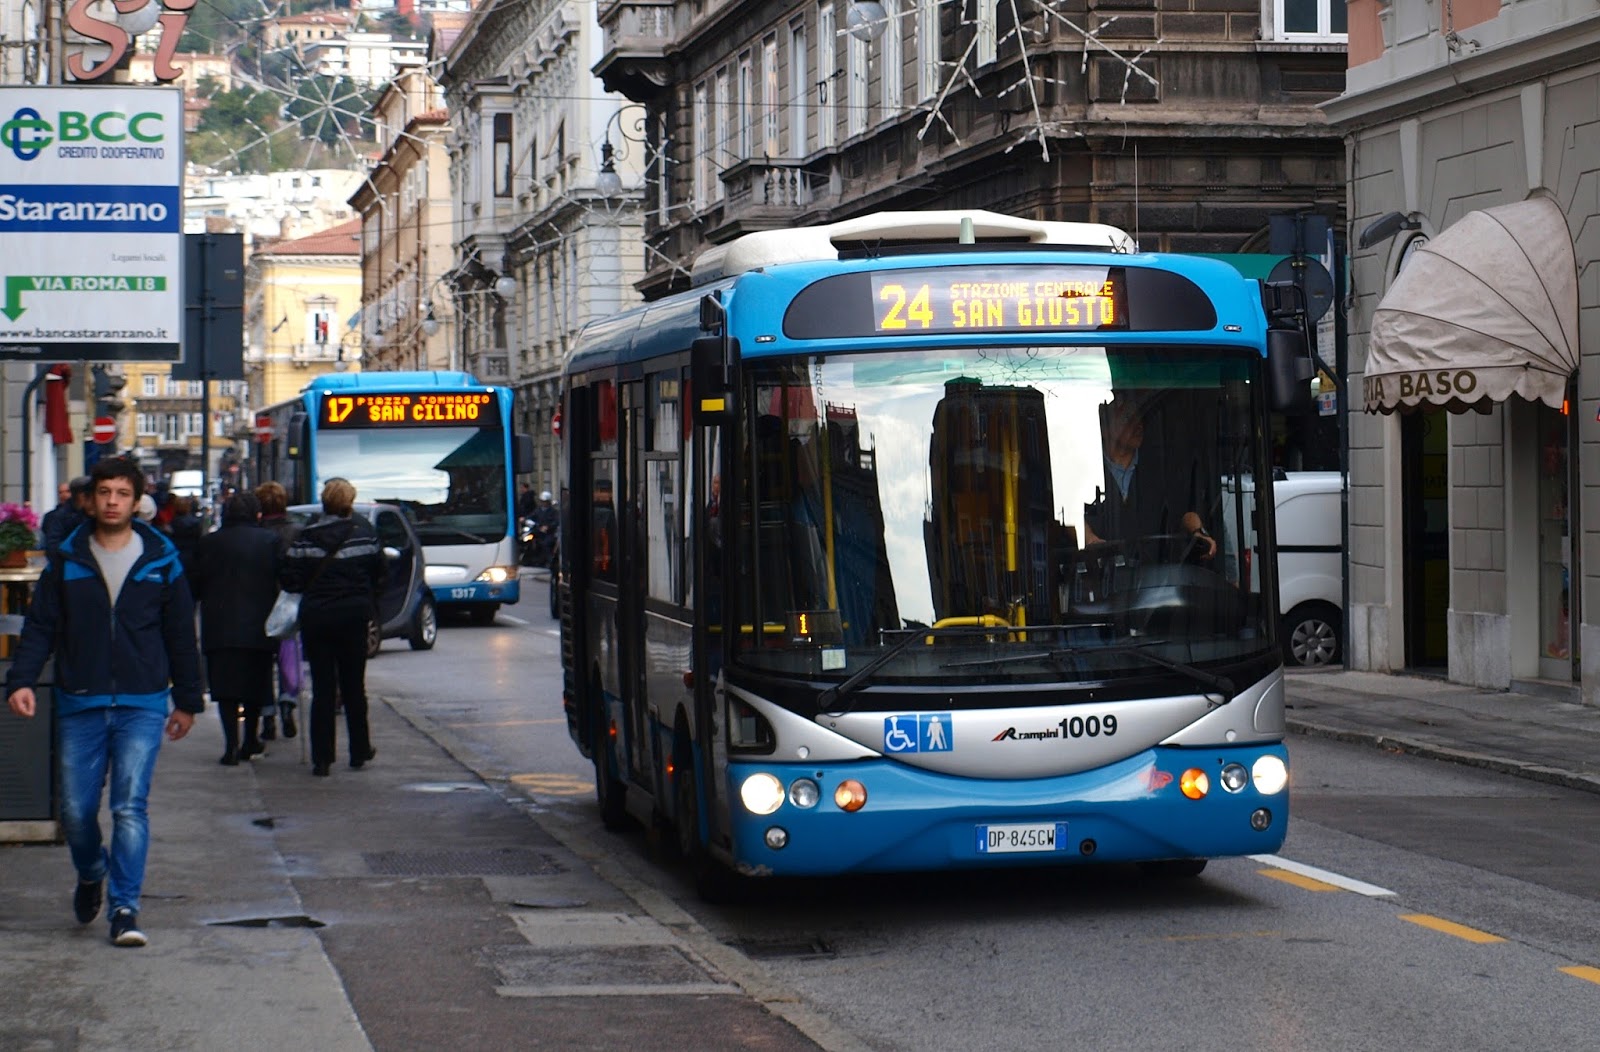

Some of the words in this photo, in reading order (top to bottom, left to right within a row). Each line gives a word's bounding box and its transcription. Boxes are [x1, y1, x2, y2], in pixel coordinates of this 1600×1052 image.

[58, 111, 164, 143] BCC
[58, 147, 98, 159] CREDITO
[101, 147, 165, 160] COOPERATIVO
[0, 195, 167, 222] Staranzano
[31, 277, 66, 290] VIA
[70, 277, 129, 290] ROMA
[136, 277, 156, 290] 18
[949, 283, 1029, 299] STAZIONE
[1034, 281, 1114, 297] CENTRALE
[879, 284, 934, 329] 24
[952, 301, 1003, 328] SAN
[1017, 298, 1115, 326] GIUSTO
[0, 328, 168, 339] www.bancastaranzano.it
[1400, 370, 1477, 398] BASO
[328, 397, 354, 423] 17
[357, 397, 411, 406] PIAZZA
[419, 395, 490, 404] TOMMASEO
[369, 405, 405, 421] SAN
[412, 403, 479, 420] CILINO
[1058, 714, 1118, 739] 1009
